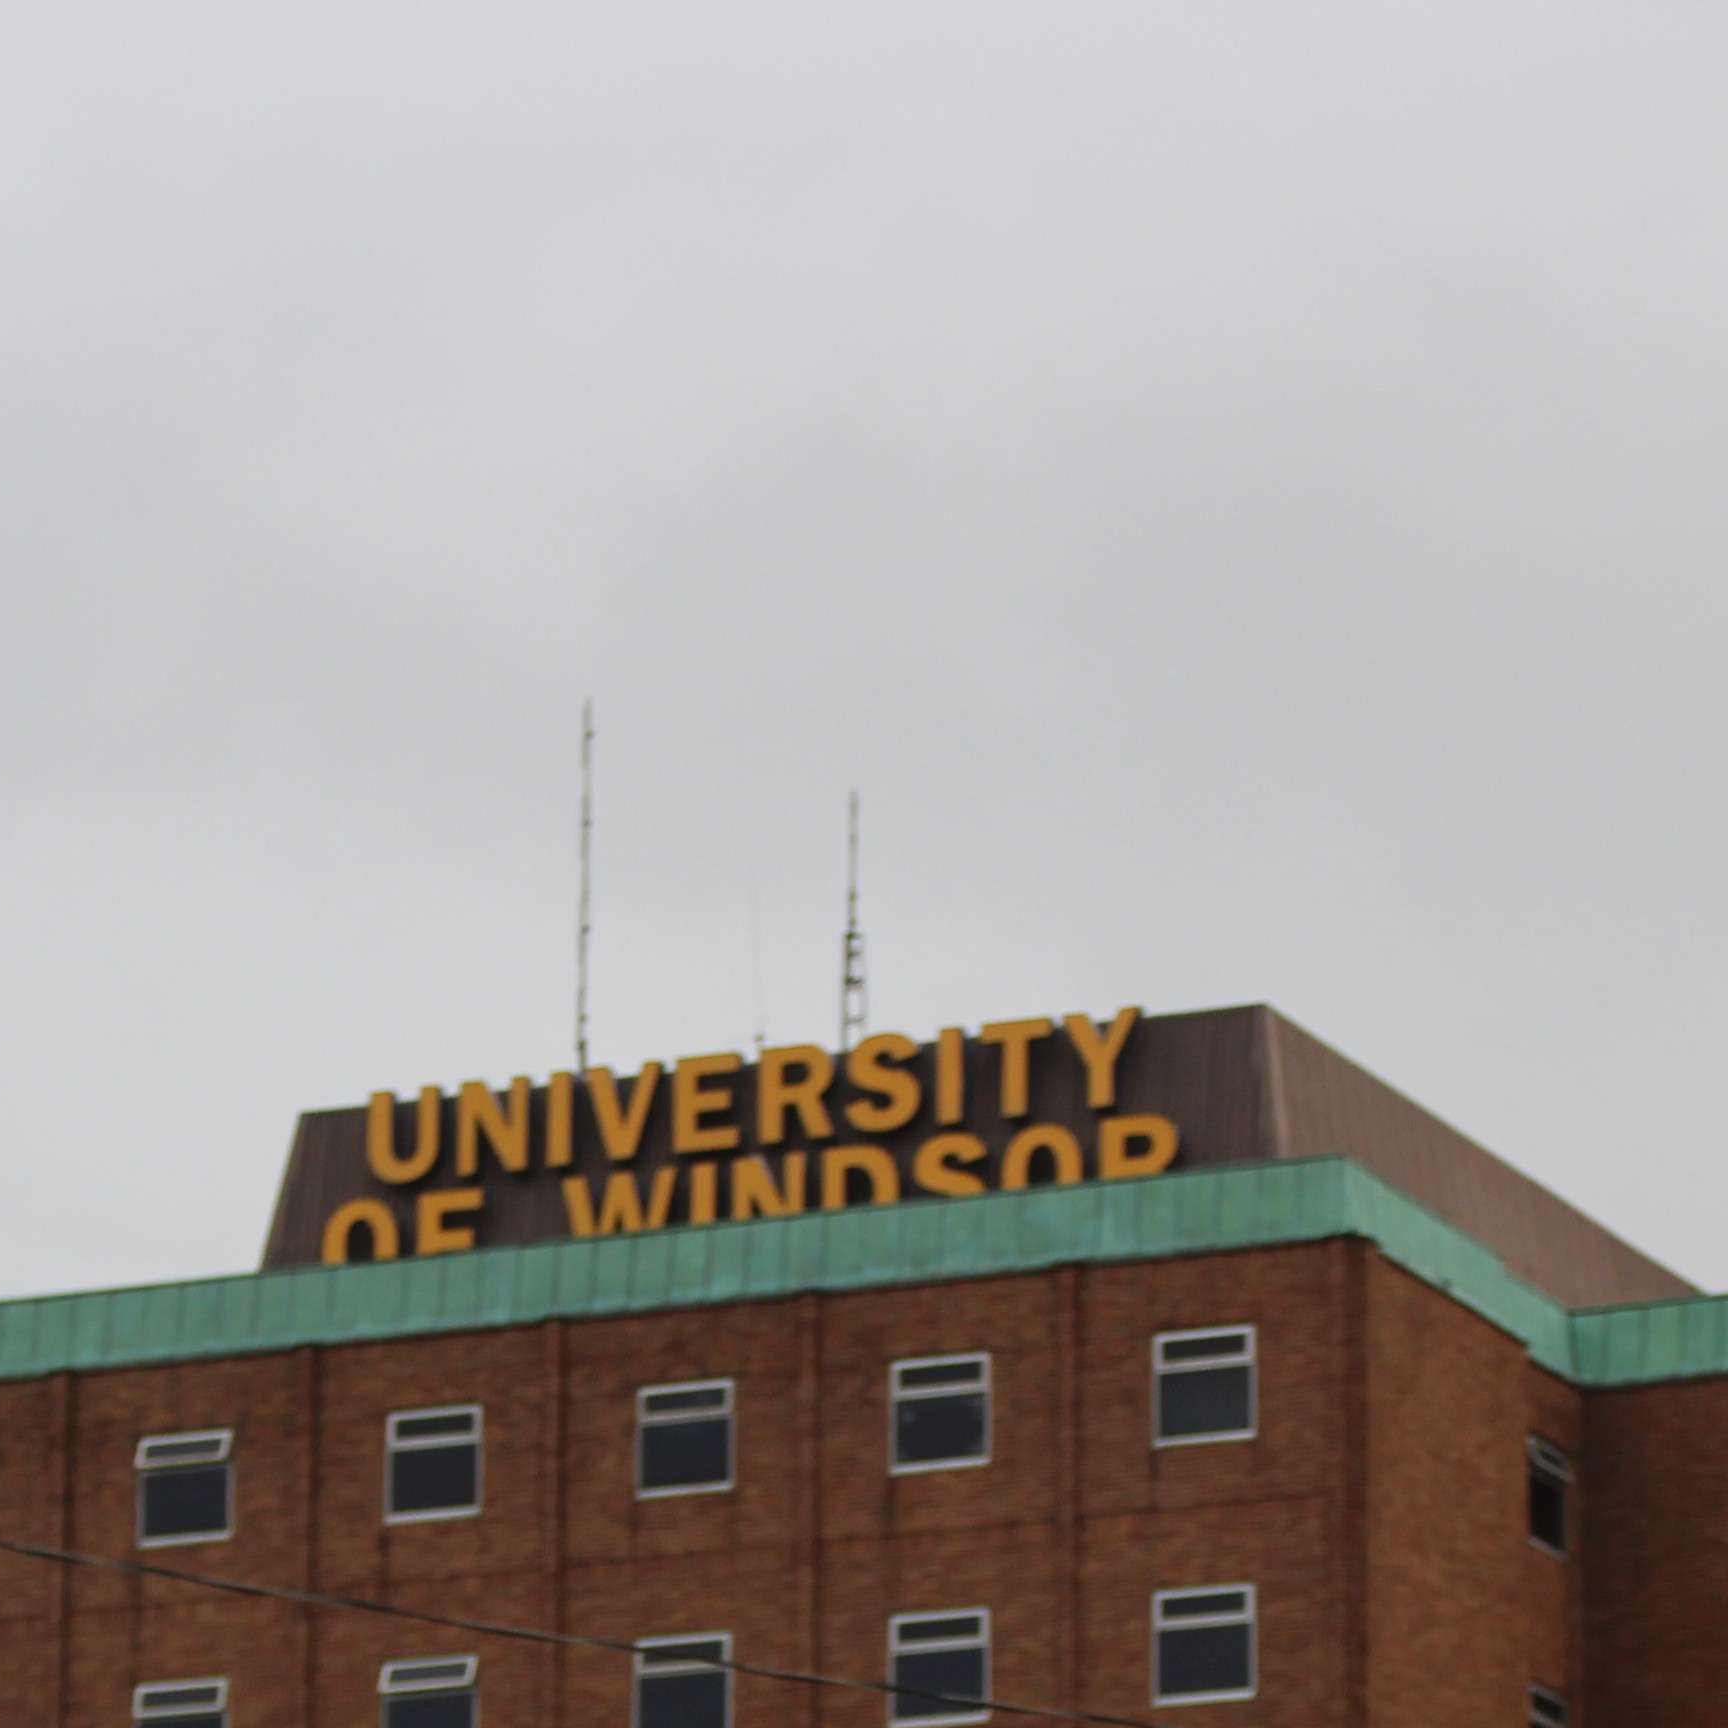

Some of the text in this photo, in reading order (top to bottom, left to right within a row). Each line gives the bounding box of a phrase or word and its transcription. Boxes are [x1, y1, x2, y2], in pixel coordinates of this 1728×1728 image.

[367, 1007, 1139, 1184] UNIVERSITY
[321, 1113, 1177, 1265] OF WINDSOR
